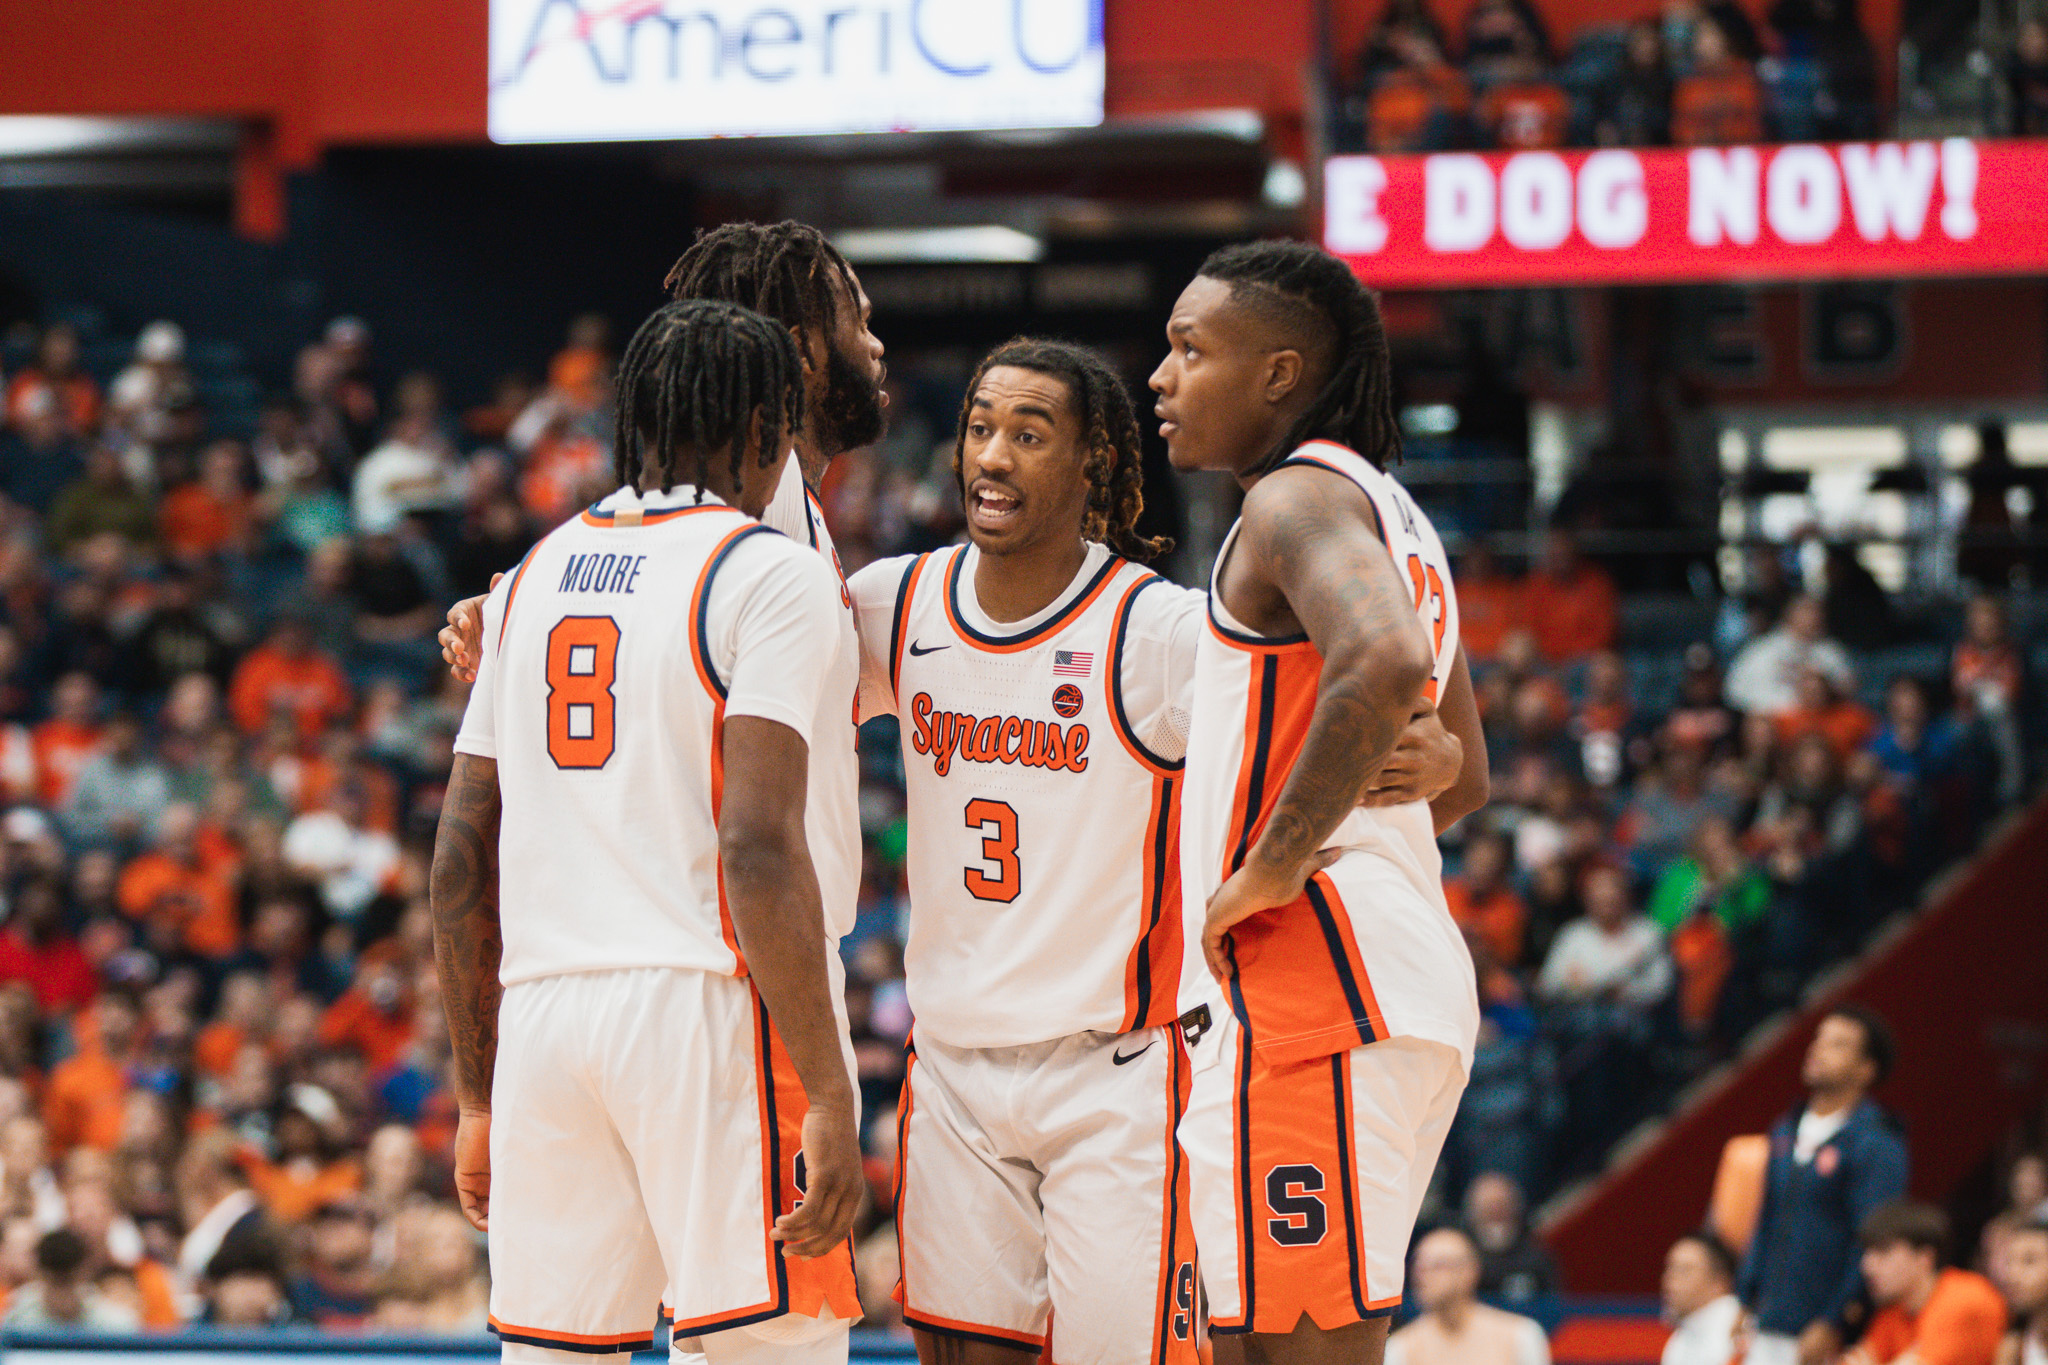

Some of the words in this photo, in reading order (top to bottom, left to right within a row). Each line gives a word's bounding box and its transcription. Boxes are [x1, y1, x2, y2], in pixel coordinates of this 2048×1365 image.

[1424, 151, 1648, 252] DOG
[1687, 137, 1979, 246] NOW!
[557, 553, 647, 593] MOORE
[545, 615, 622, 770] 8
[912, 692, 1090, 777] Syracuse
[963, 797, 1021, 904] 3
[1265, 1163, 1328, 1247] S
